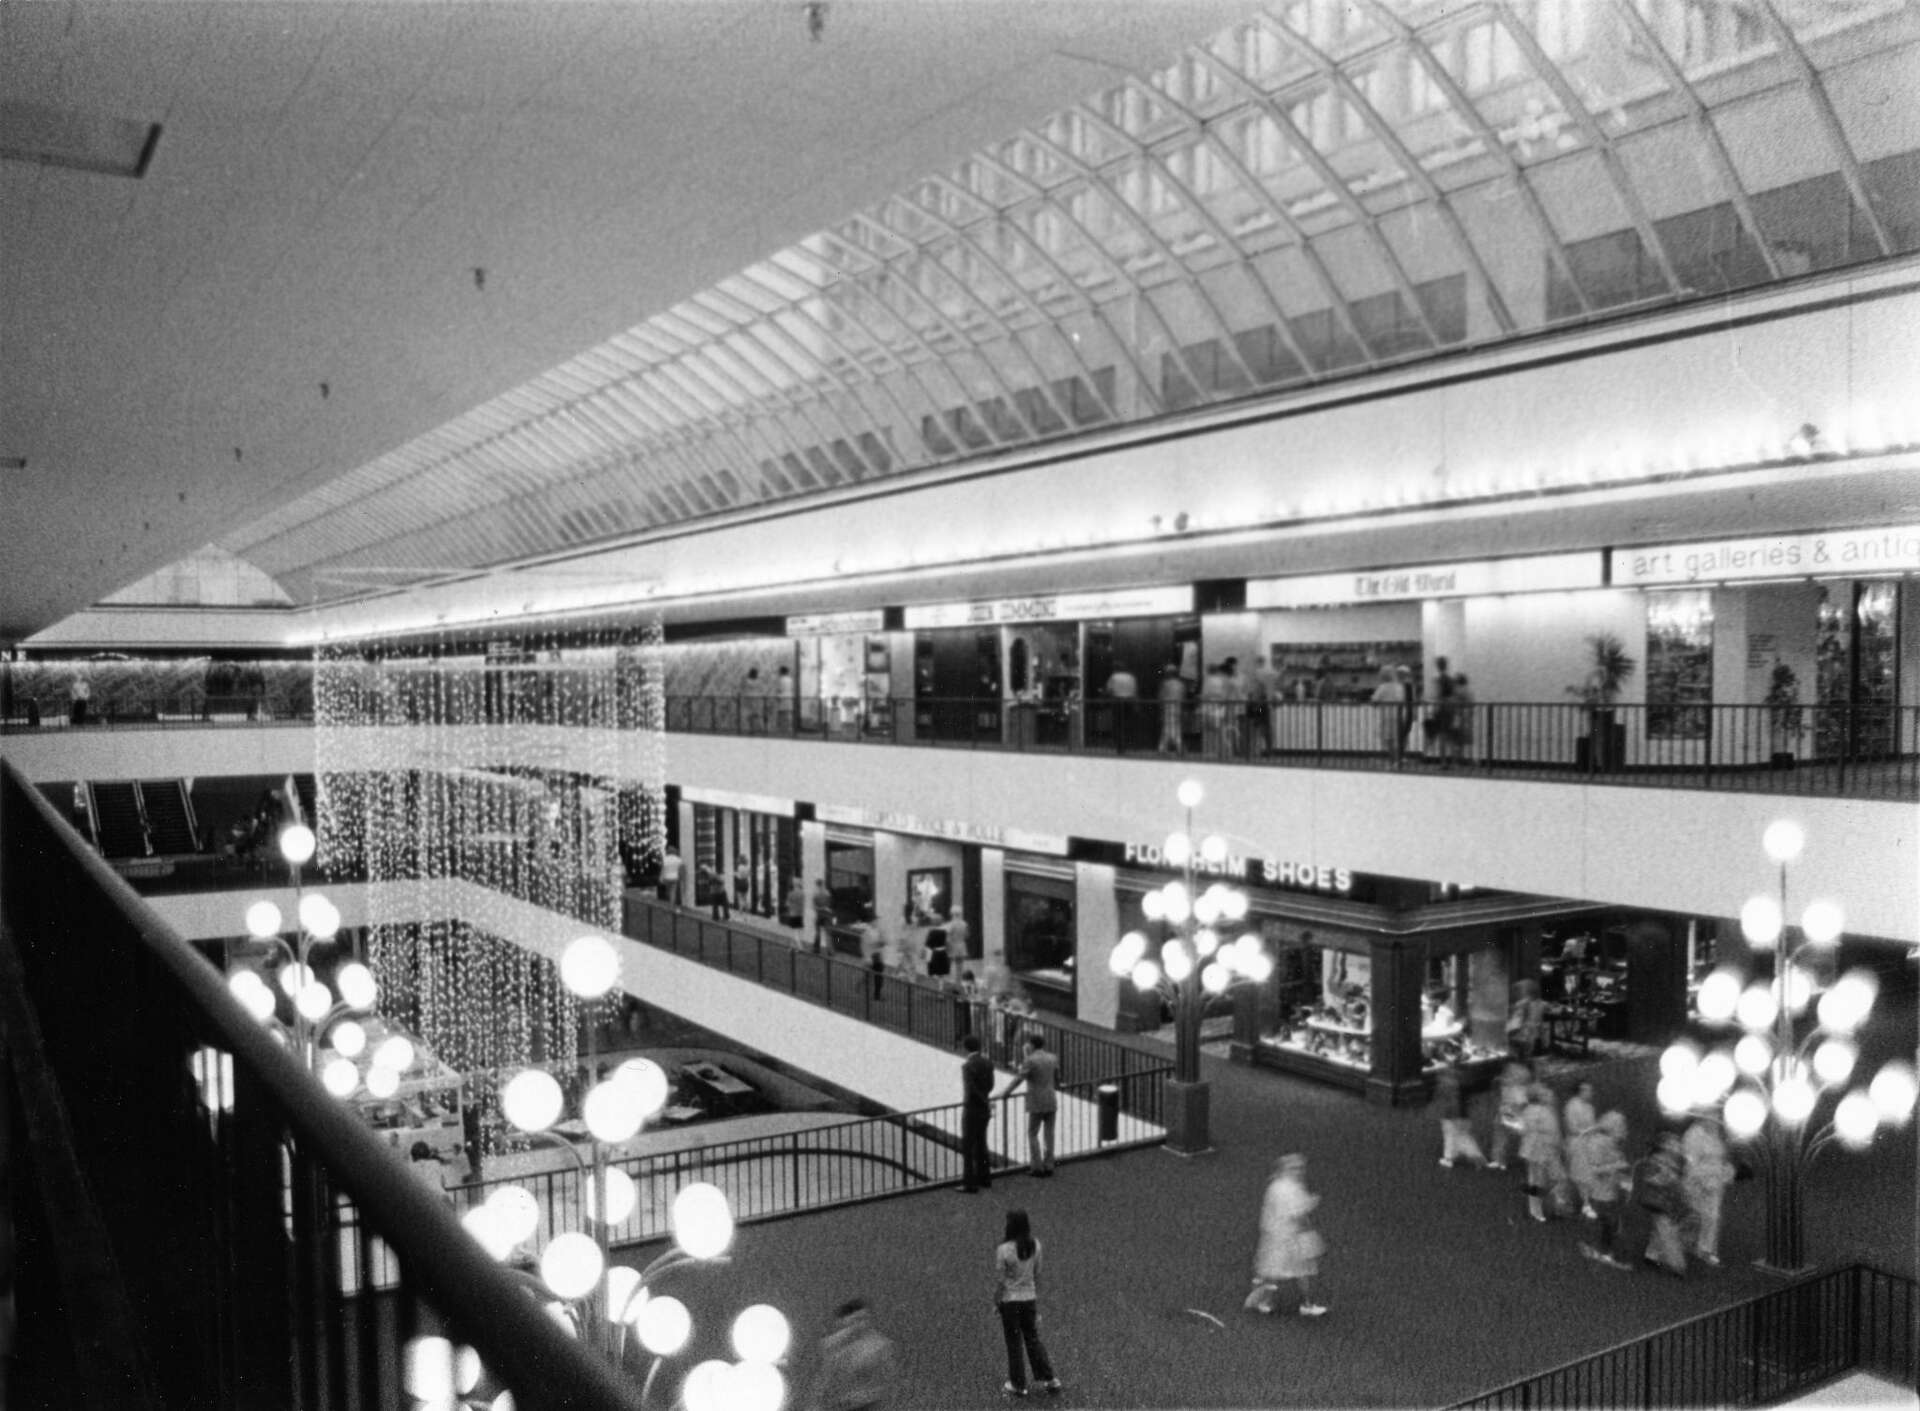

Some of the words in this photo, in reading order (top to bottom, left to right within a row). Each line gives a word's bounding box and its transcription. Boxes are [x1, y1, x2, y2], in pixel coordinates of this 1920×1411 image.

[1632, 553, 1674, 577] art
[1684, 544, 1802, 581] galleries
[1813, 539, 1830, 564] &
[1262, 857, 1353, 892] SHOES
